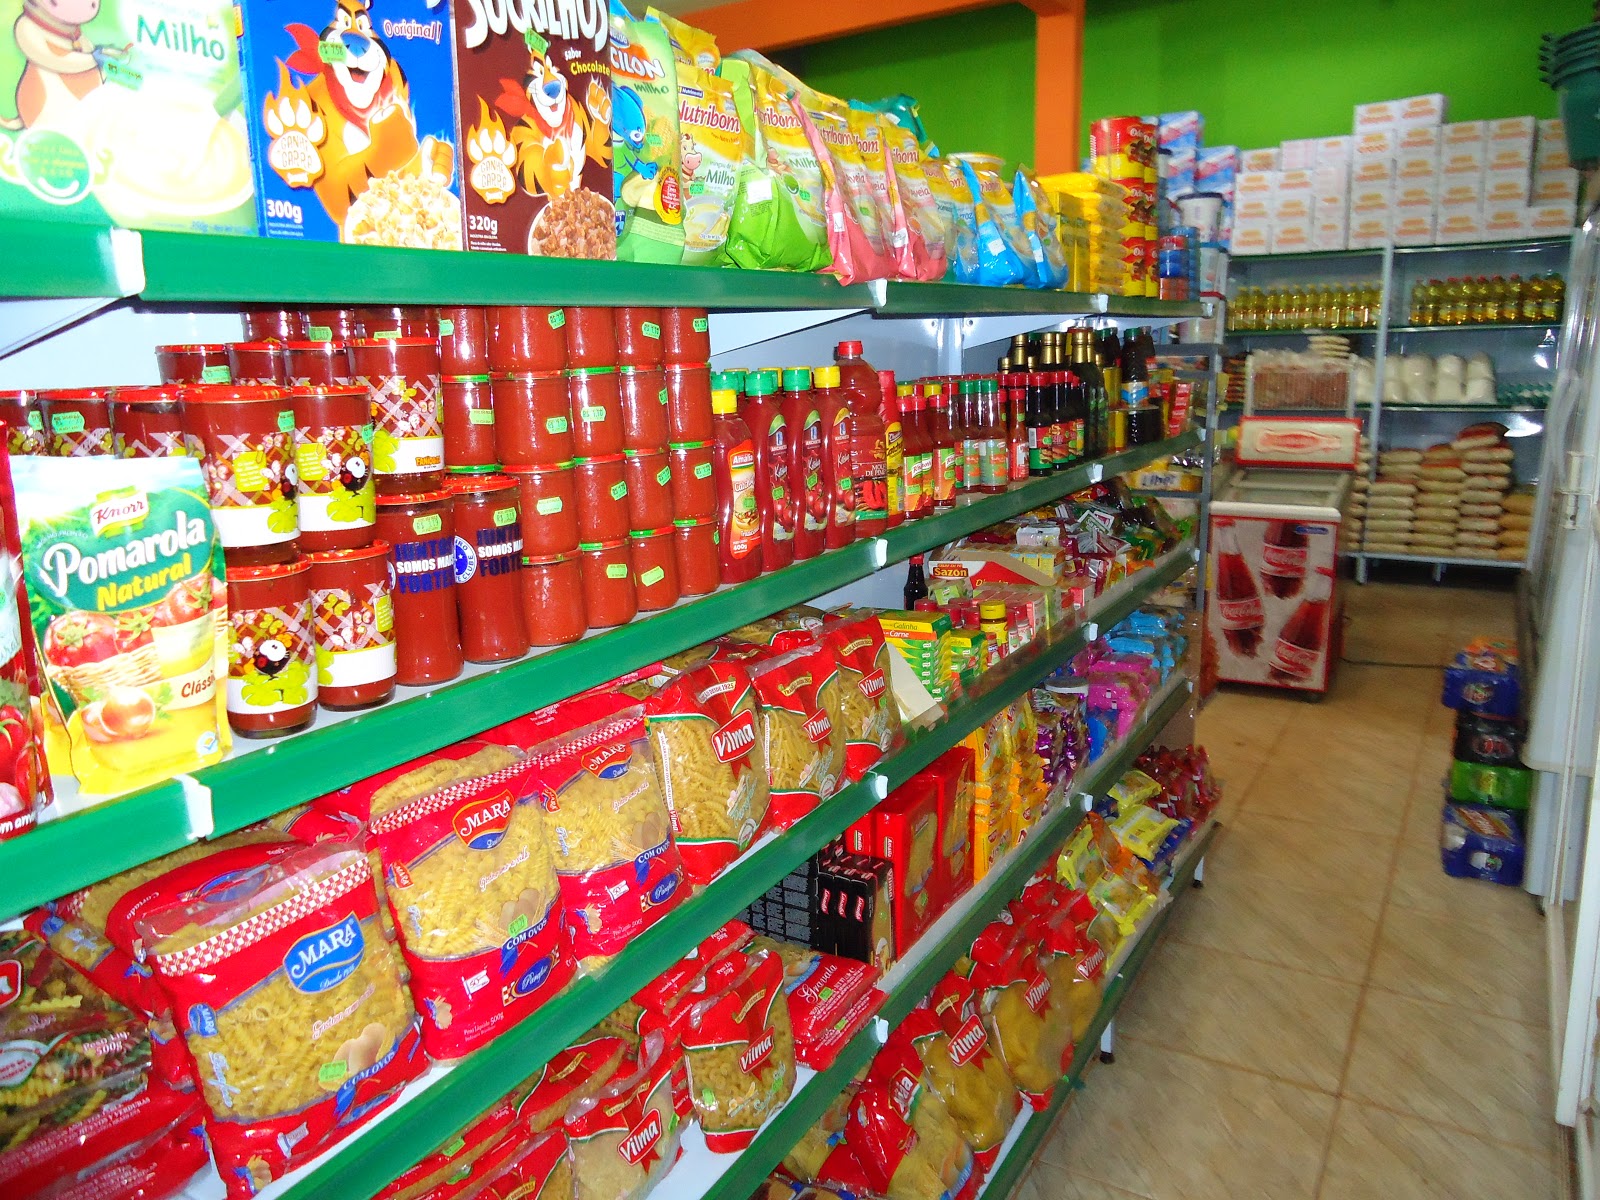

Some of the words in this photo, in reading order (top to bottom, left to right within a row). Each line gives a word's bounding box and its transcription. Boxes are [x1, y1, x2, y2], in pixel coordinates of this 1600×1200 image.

[137, 15, 224, 61] Milho
[564, 48, 582, 61] sabor
[570, 61, 611, 76] Chocolate
[706, 169, 735, 187] Milho
[266, 199, 303, 223] 300g
[469, 215, 498, 235] 320g
[92, 501, 145, 524] Knorr
[39, 510, 207, 598] Pomarola
[478, 542, 513, 558] SOMOS
[396, 558, 436, 574] SOMOS
[96, 552, 192, 612] Natural
[889, 630, 910, 638] Carne
[893, 622, 918, 631] Galinha
[860, 674, 885, 696] Vilma
[806, 716, 831, 739] Vilma
[715, 723, 755, 757] Vilma
[460, 798, 512, 837] MARA
[638, 850, 655, 864] COM
[506, 933, 527, 951] COM
[528, 918, 548, 937] OVOS
[291, 922, 357, 979] MARA
[1077, 947, 1105, 977] Vilma
[1025, 977, 1051, 1009] Vilma
[96, 1040, 122, 1056] 500g
[740, 1034, 773, 1071] Vilma
[950, 1024, 985, 1063] Vilma
[343, 1069, 370, 1091] COM
[371, 1051, 396, 1074] OVOS
[619, 1120, 659, 1162] Vilma
